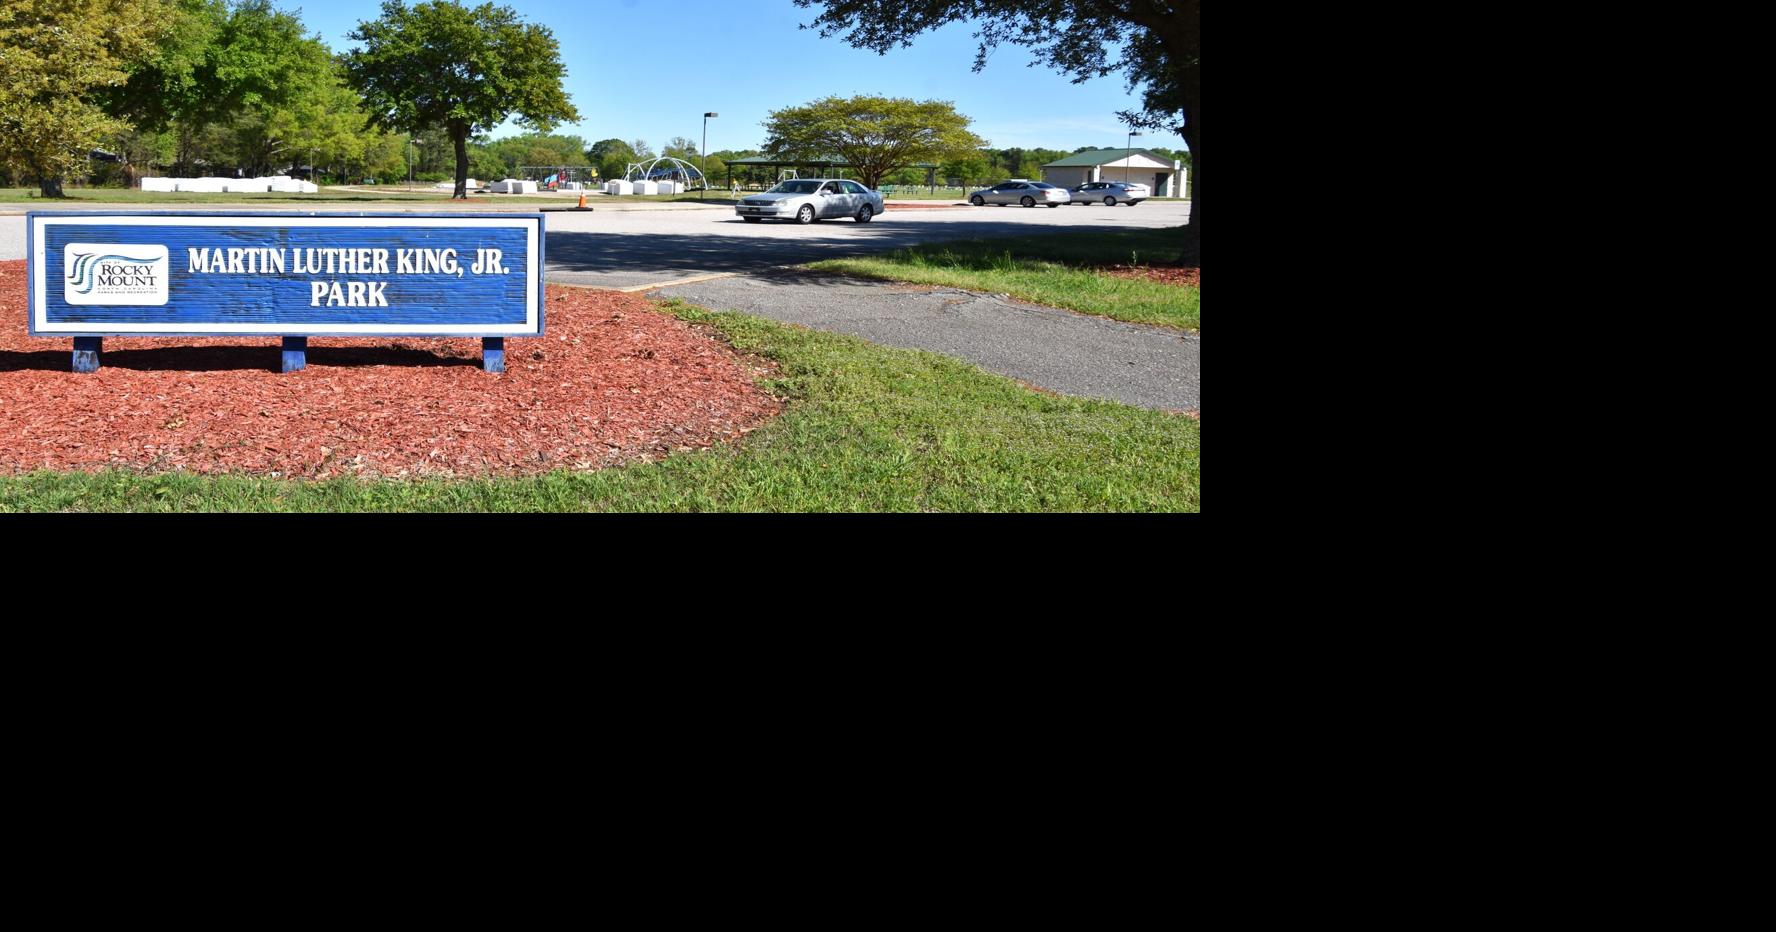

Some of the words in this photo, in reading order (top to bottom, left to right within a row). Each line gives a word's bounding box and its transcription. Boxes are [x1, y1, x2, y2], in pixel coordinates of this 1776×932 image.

[103, 265, 153, 275] ROCKY
[188, 248, 285, 273] MARTIN
[293, 248, 389, 273] LUTHER
[396, 248, 464, 278] KING,
[471, 249, 510, 275] JR.
[98, 275, 157, 286] MOUNT
[310, 281, 388, 307] PARK
